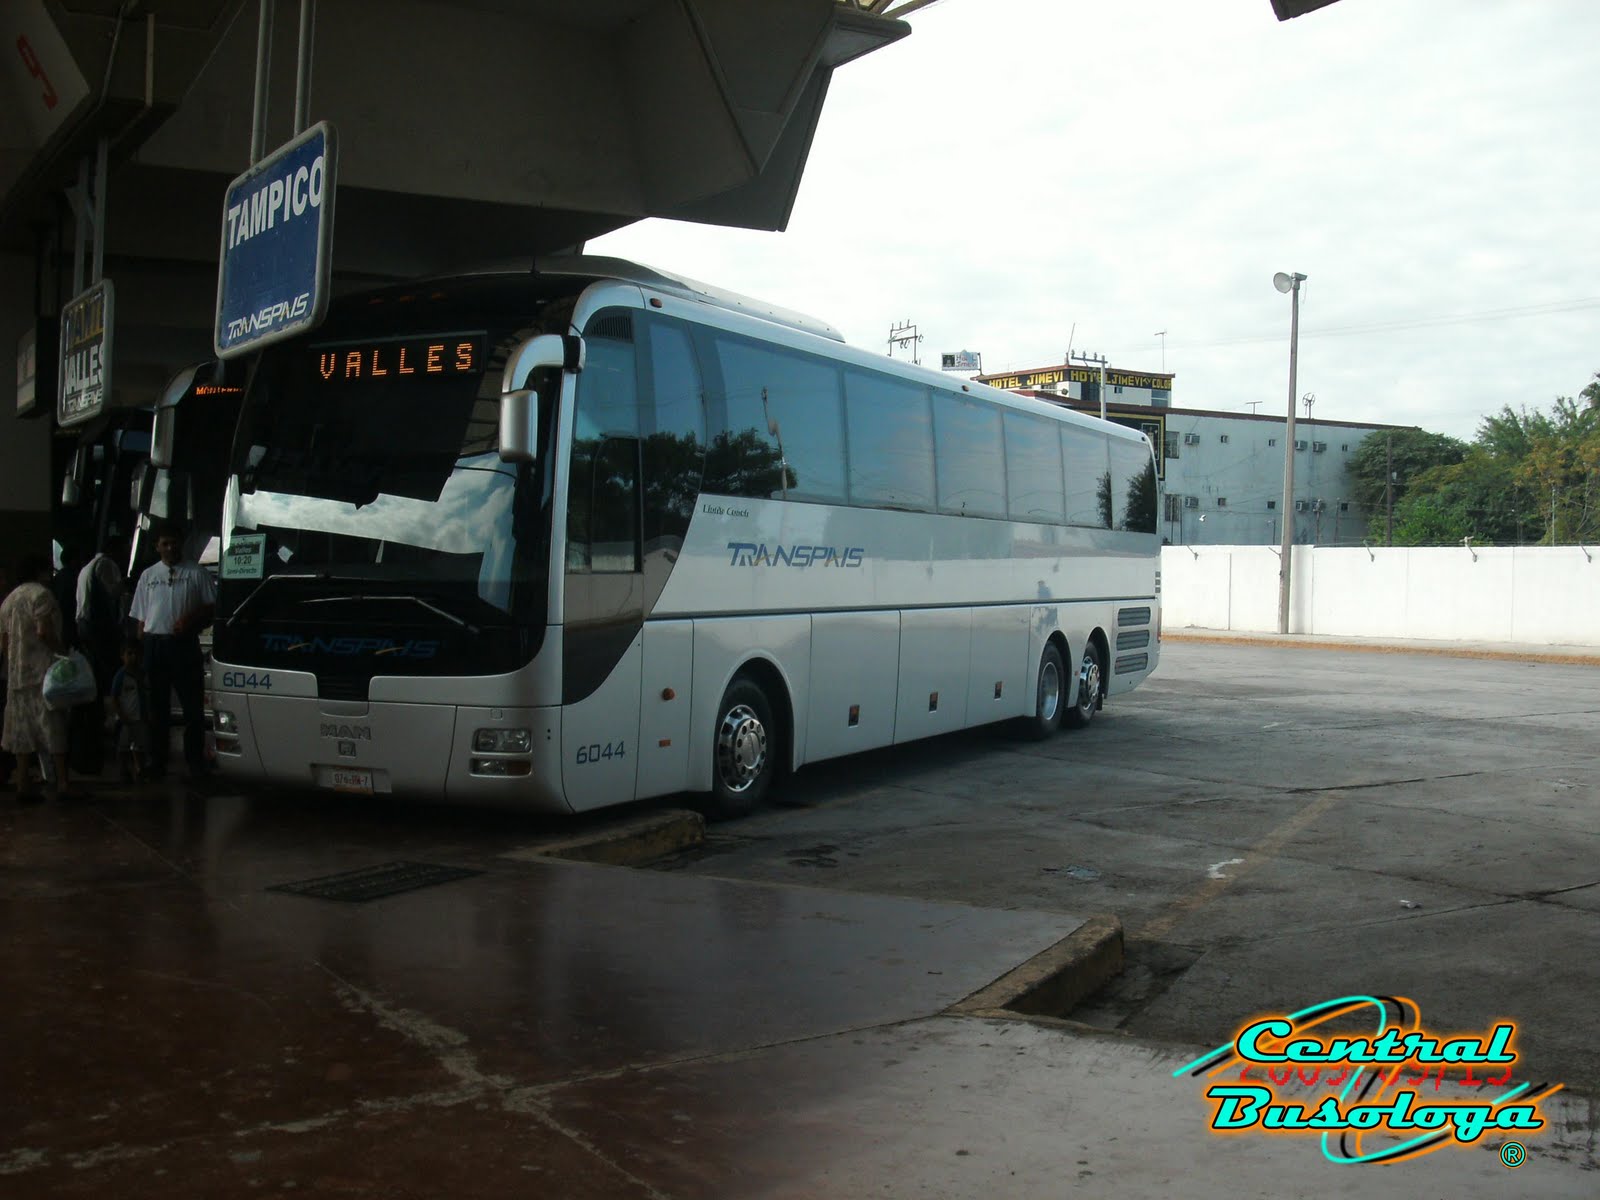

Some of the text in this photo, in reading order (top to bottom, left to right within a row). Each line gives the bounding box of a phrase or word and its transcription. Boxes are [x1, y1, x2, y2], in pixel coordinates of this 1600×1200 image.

[17, 34, 57, 110] 9
[228, 156, 324, 250] TAMPICO
[320, 343, 472, 379] VALLES
[989, 377, 1022, 388] HOTEL
[727, 542, 864, 568] TRANSPAIS
[223, 672, 272, 690] 6044
[576, 741, 625, 764] 6044
